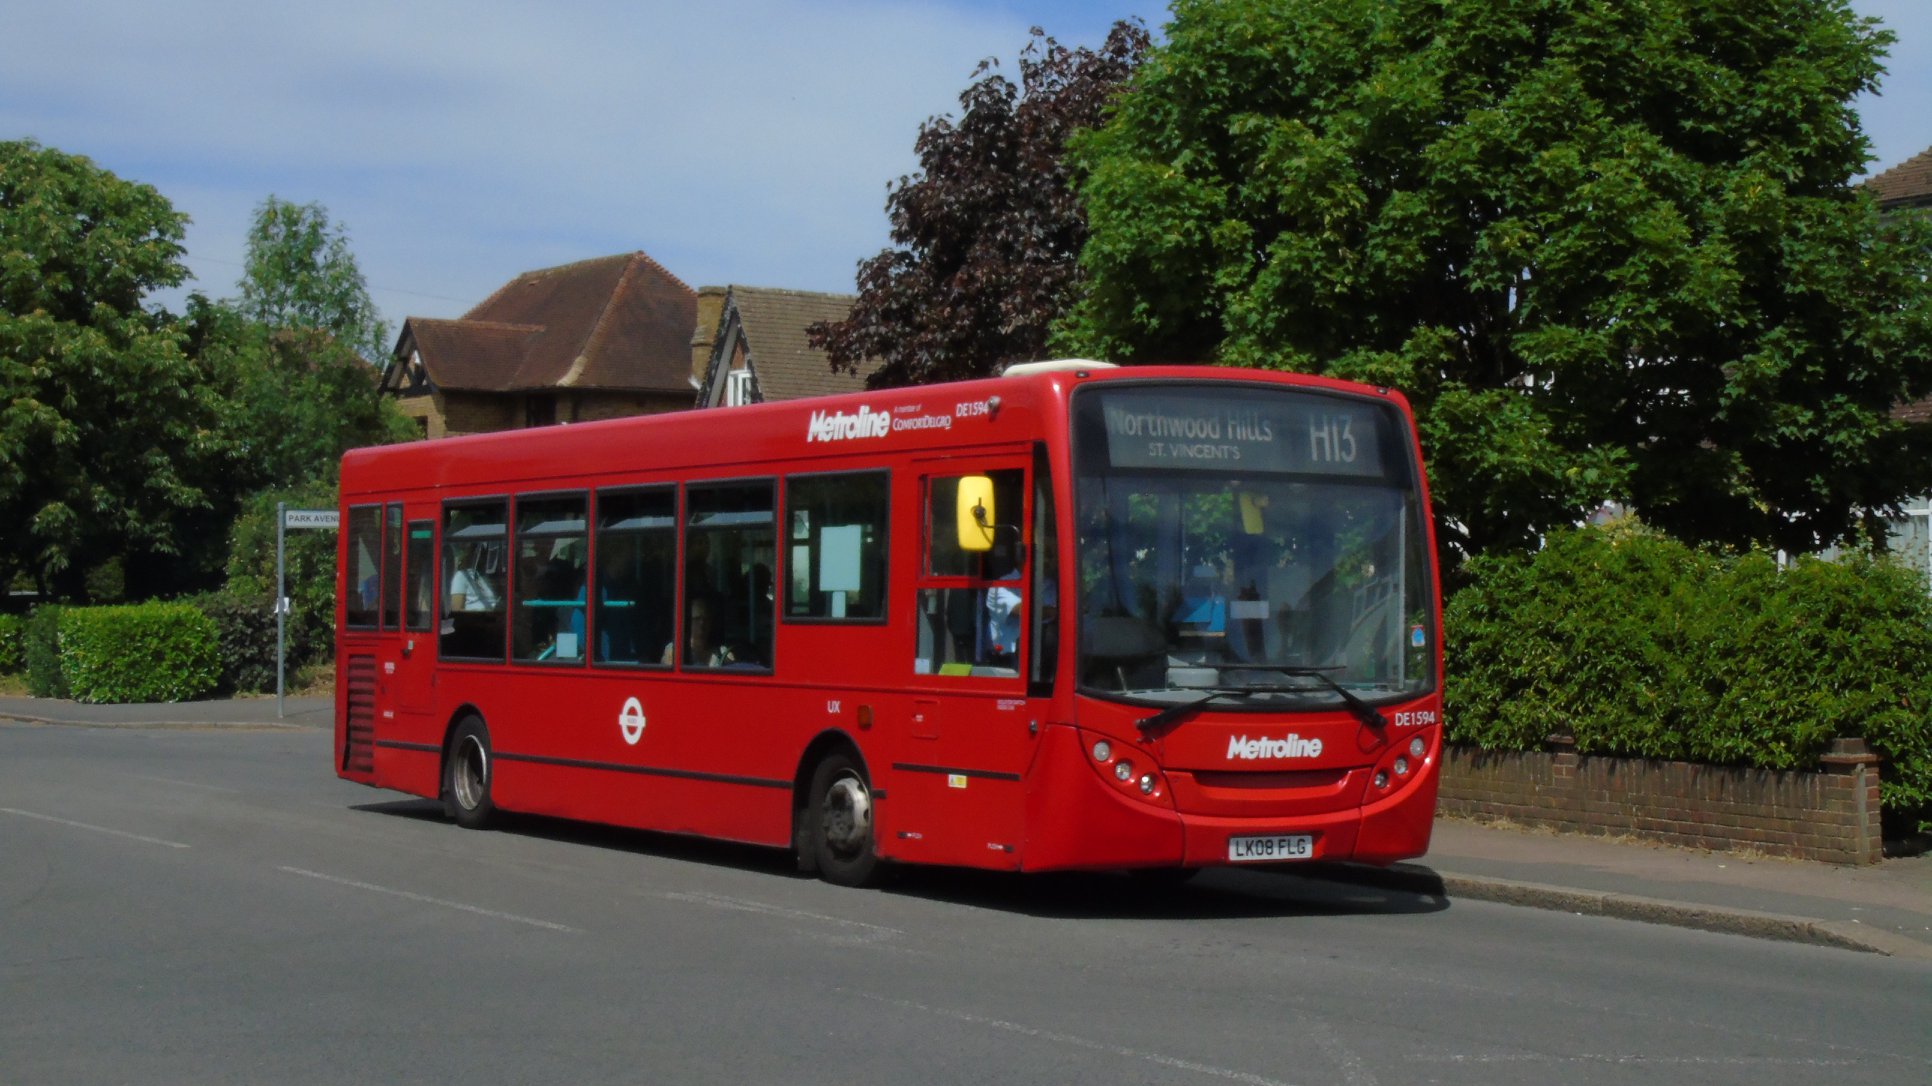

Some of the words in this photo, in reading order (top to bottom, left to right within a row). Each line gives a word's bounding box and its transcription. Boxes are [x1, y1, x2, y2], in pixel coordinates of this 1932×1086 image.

[956, 401, 989, 417] DE1594
[808, 406, 890, 442] Metroline
[1228, 410, 1273, 442] Hills
[1309, 414, 1357, 462] H13
[827, 700, 841, 713] UX
[1395, 711, 1436, 727] DE1594
[1227, 734, 1322, 759] Metroline
[1235, 840, 1274, 857] LK08
[1278, 838, 1306, 855] FLG
